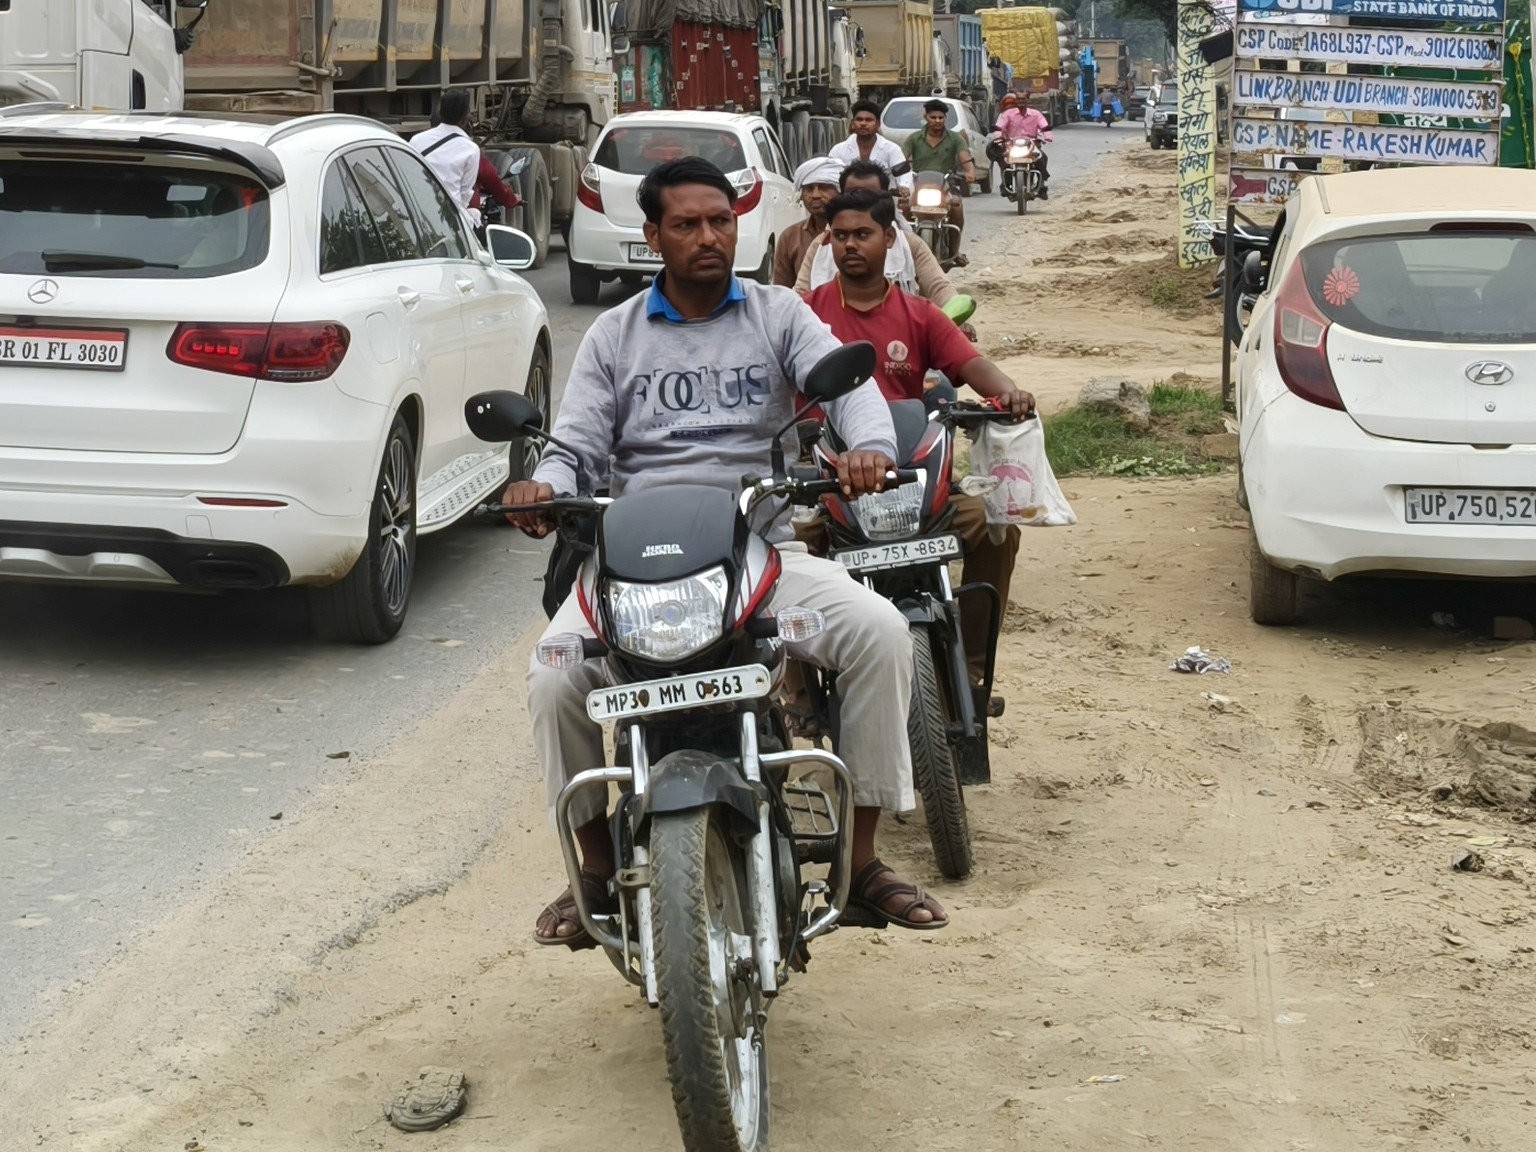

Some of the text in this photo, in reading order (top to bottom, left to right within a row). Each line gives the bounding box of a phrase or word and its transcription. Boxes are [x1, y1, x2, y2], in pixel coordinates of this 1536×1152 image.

[1354, 0, 1498, 18] STATE BANK OF INDIA
[1238, 28, 1265, 48] CSP
[1424, 132, 1488, 162] KUMAR
[22, 341, 40, 360] 01
[46, 341, 73, 361] FL
[77, 343, 118, 363] 3030
[1505, 496, 1536, 518] 52
[852, 551, 869, 566] UP
[882, 545, 909, 562] 75X
[659, 684, 686, 705] MM
